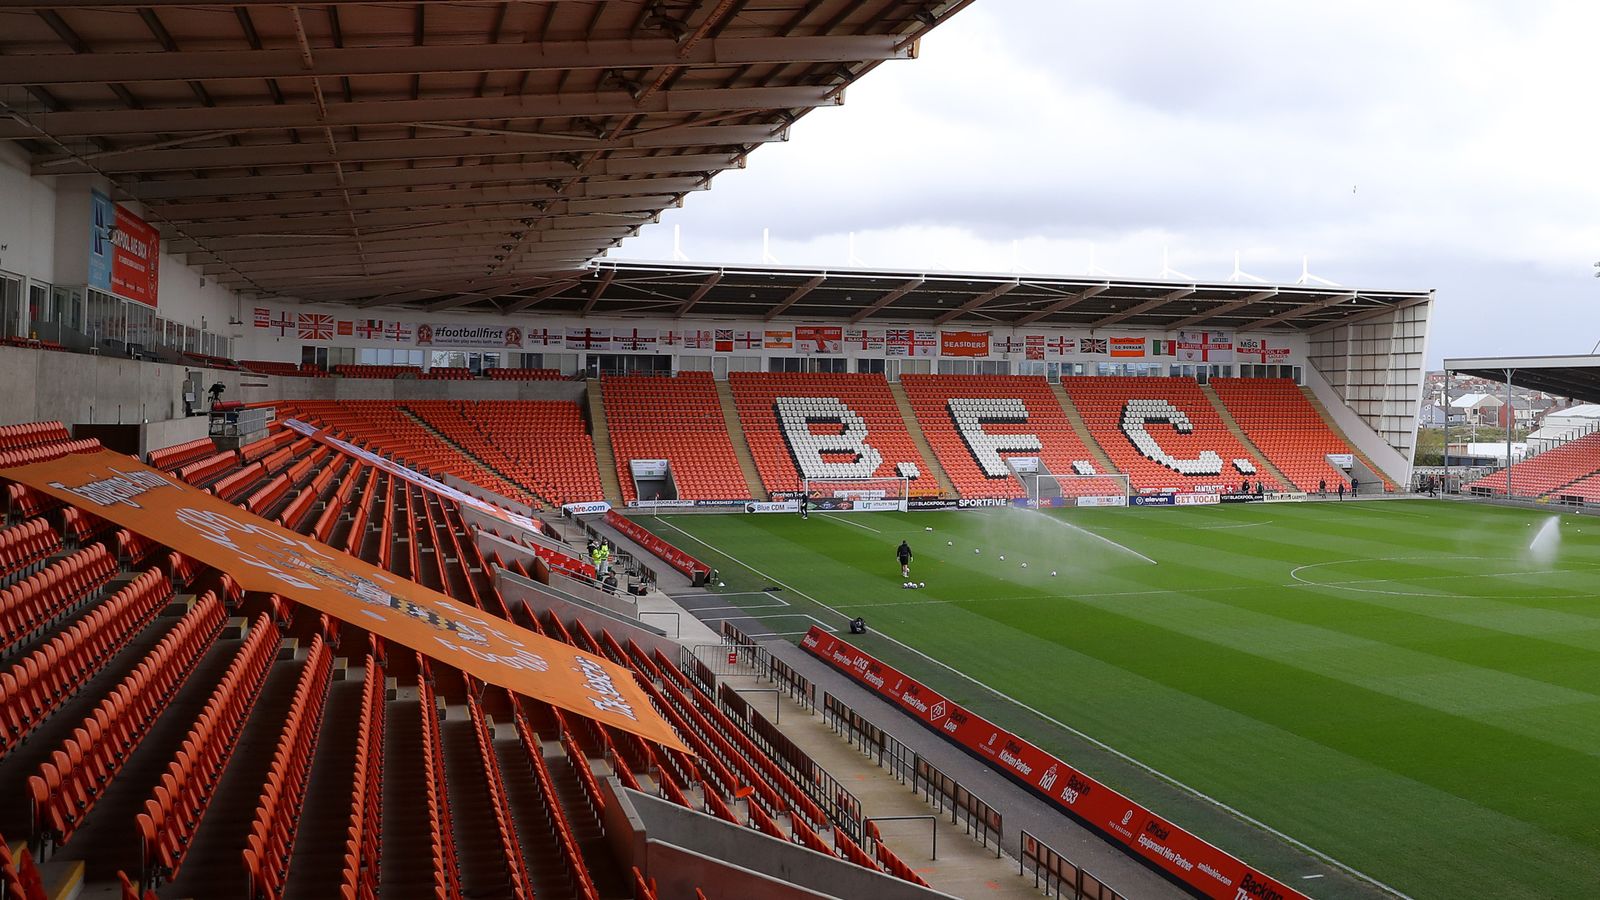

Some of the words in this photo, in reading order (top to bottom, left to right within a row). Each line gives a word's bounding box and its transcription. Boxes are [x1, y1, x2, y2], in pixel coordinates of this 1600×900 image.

[435, 326, 503, 339] #footballfirst
[958, 499, 1007, 507] SPORTFIVE
[1176, 496, 1191, 504] GET
[1194, 495, 1220, 503] VOCAL
[944, 718, 958, 732] Love
[998, 748, 1018, 768] Kitchen
[1014, 758, 1032, 776] Partner
[1038, 769, 1058, 792] hdl
[1060, 786, 1078, 804] 1953
[1146, 820, 1170, 840] Official
[1138, 833, 1165, 855] Equipment
[1162, 847, 1176, 861] Hire
[1173, 853, 1194, 872] Partner
[1197, 862, 1232, 886] smithshire.com
